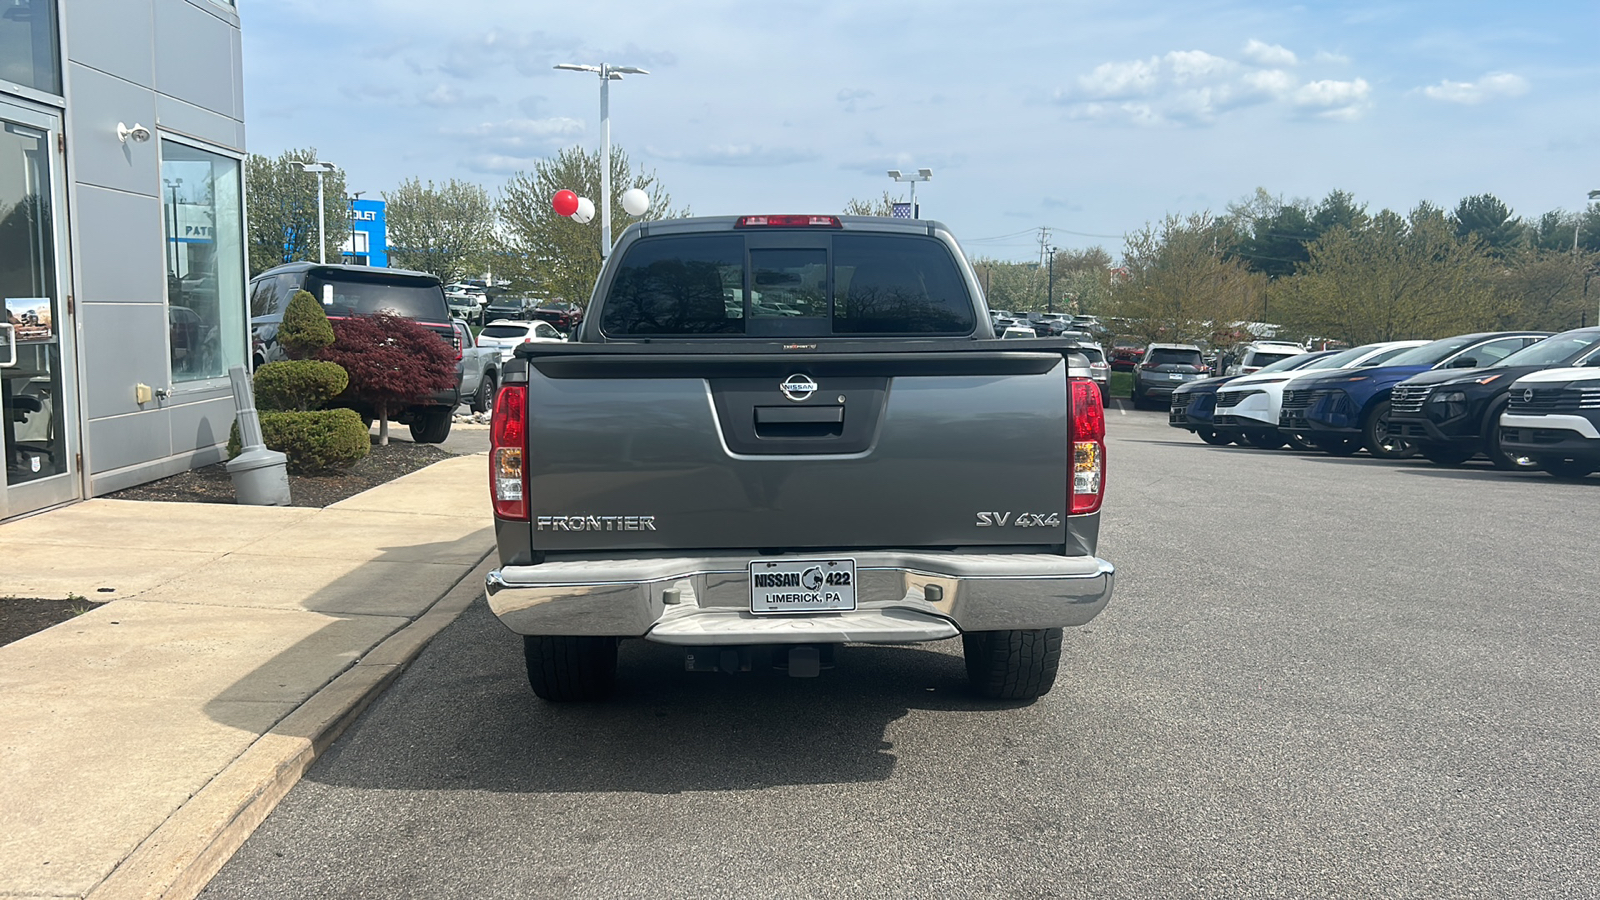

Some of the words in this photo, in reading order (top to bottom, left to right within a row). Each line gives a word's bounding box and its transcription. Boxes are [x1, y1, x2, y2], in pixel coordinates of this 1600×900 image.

[537, 515, 657, 531] FRONTIER
[976, 511, 1012, 527] SV
[754, 573, 801, 588] NISSAN
[825, 571, 852, 587] 422
[765, 593, 823, 604] LIMERICK,
[825, 592, 841, 602] PA
